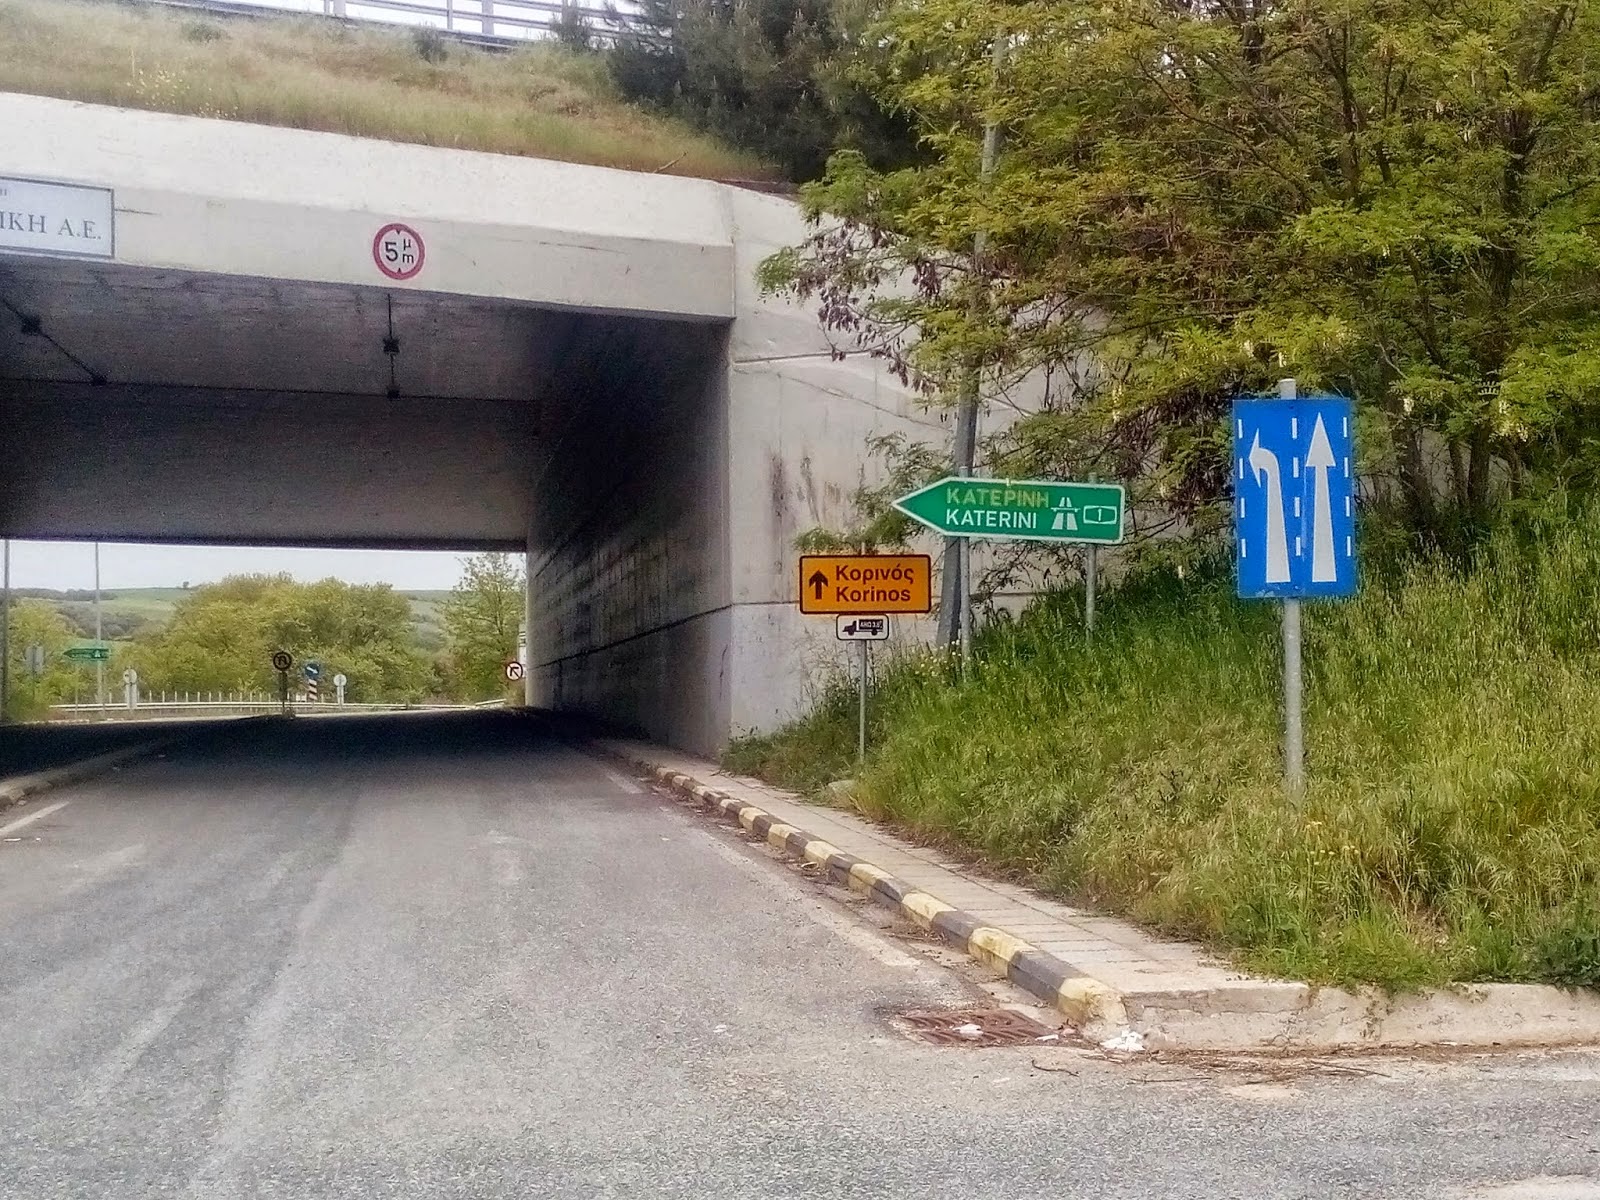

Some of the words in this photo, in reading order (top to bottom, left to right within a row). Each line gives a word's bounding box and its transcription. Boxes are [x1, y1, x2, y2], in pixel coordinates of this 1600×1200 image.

[385, 241, 398, 262] 5
[402, 253, 414, 264] m
[946, 487, 1050, 509] ΚΑΤΕΡΙΝΗ
[945, 508, 1038, 529] KATERINI
[835, 563, 915, 585] Κορινός
[836, 586, 911, 602] Korinos
